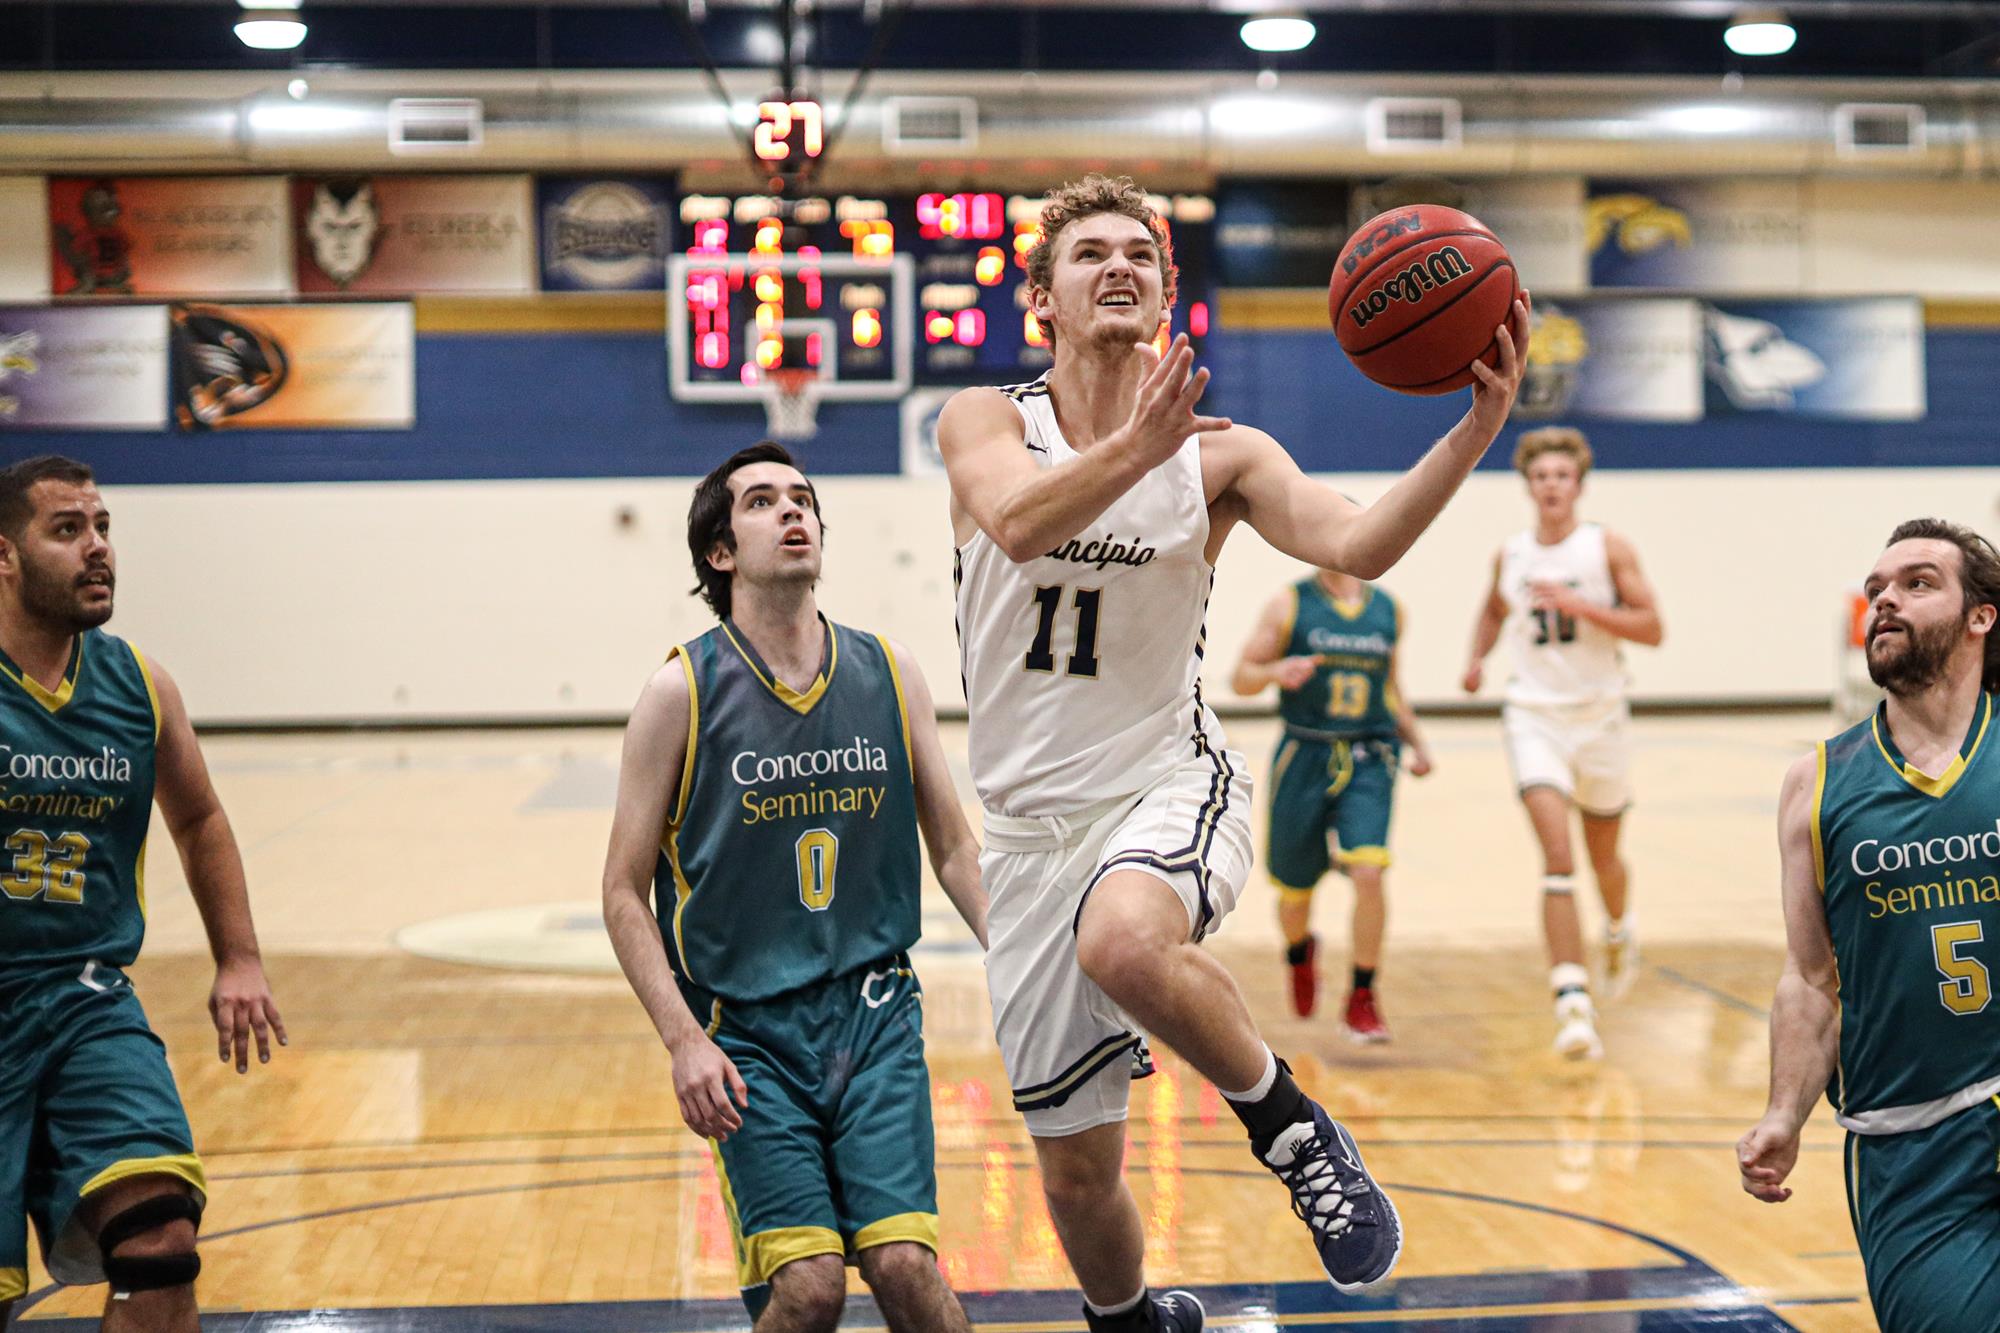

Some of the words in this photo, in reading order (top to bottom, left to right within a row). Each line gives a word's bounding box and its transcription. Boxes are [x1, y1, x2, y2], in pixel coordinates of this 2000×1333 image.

[755, 101, 823, 160] 27
[1343, 213, 1421, 275] NCAA
[1350, 246, 1474, 328] Wilson
[1023, 583, 1104, 680] 11
[731, 736, 888, 785] Concordia
[742, 781, 885, 824] Seminary
[0, 828, 91, 905] 32
[795, 827, 839, 912] 0
[1865, 869, 2000, 919] Semina
[1930, 919, 1992, 1016] 5
